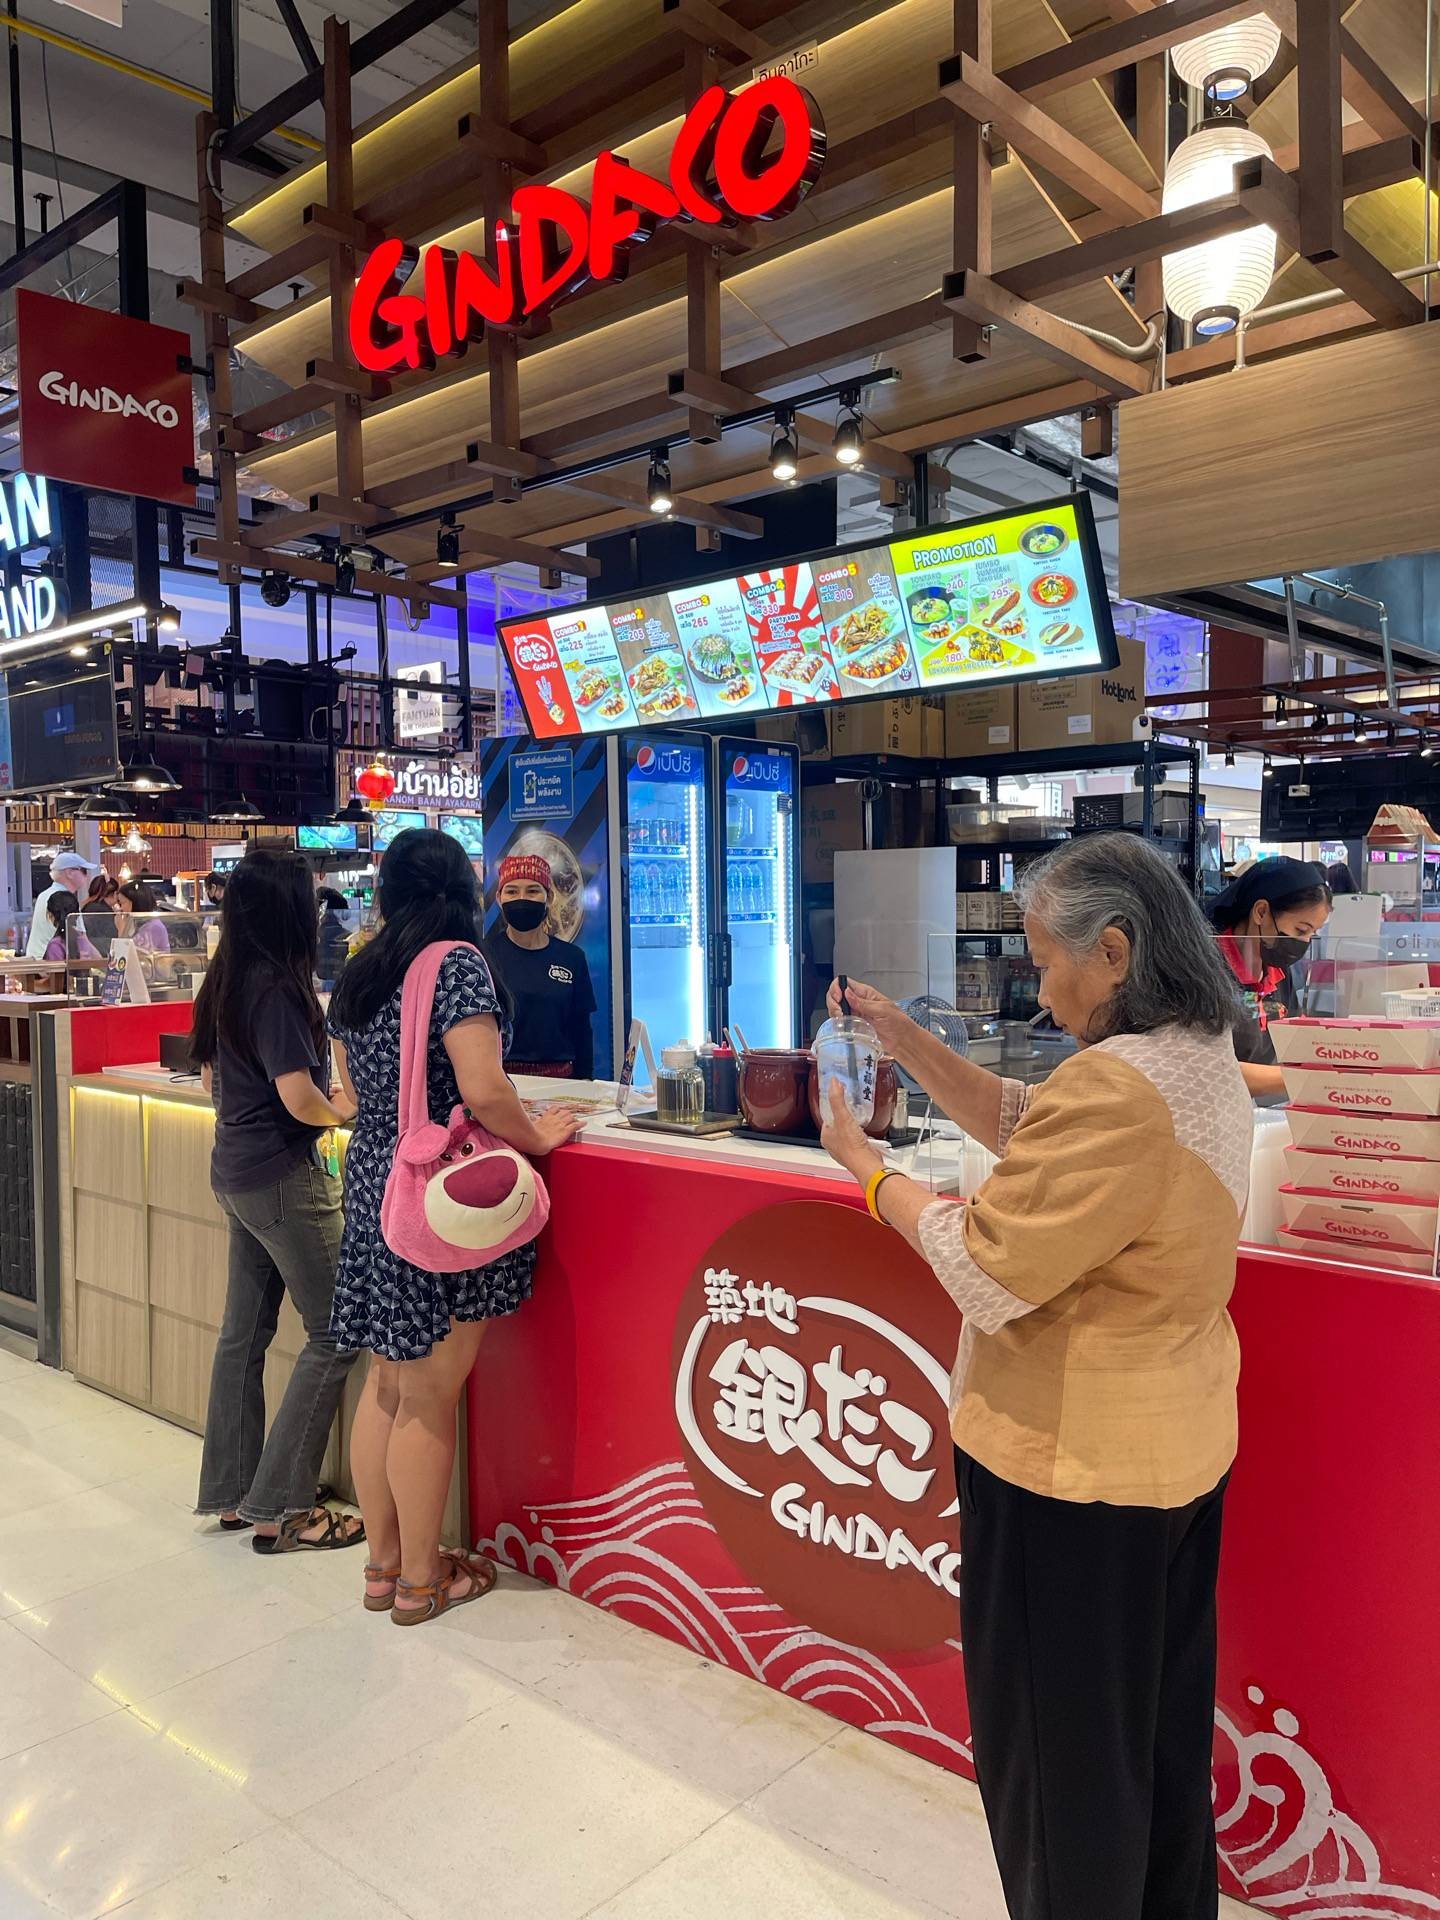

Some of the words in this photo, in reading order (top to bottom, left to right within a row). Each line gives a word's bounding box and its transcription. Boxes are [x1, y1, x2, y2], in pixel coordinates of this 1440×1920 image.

[349, 75, 813, 371] GINDACO
[38, 371, 179, 428] GINDACO
[912, 535, 997, 569] PROMOTION
[692, 616, 708, 628] 265
[568, 639, 584, 651] 225
[418, 797, 442, 807] BAAN
[1315, 1047, 1379, 1061] GINDACO
[863, 1054, 874, 1101] 幸福堂
[1328, 1091, 1392, 1106] GINDACO
[1334, 1136, 1401, 1152] GINDACO
[1333, 1175, 1400, 1192] GINDACO
[1325, 1222, 1389, 1240] GINDACO
[709, 1339, 937, 1502] 銀だこ
